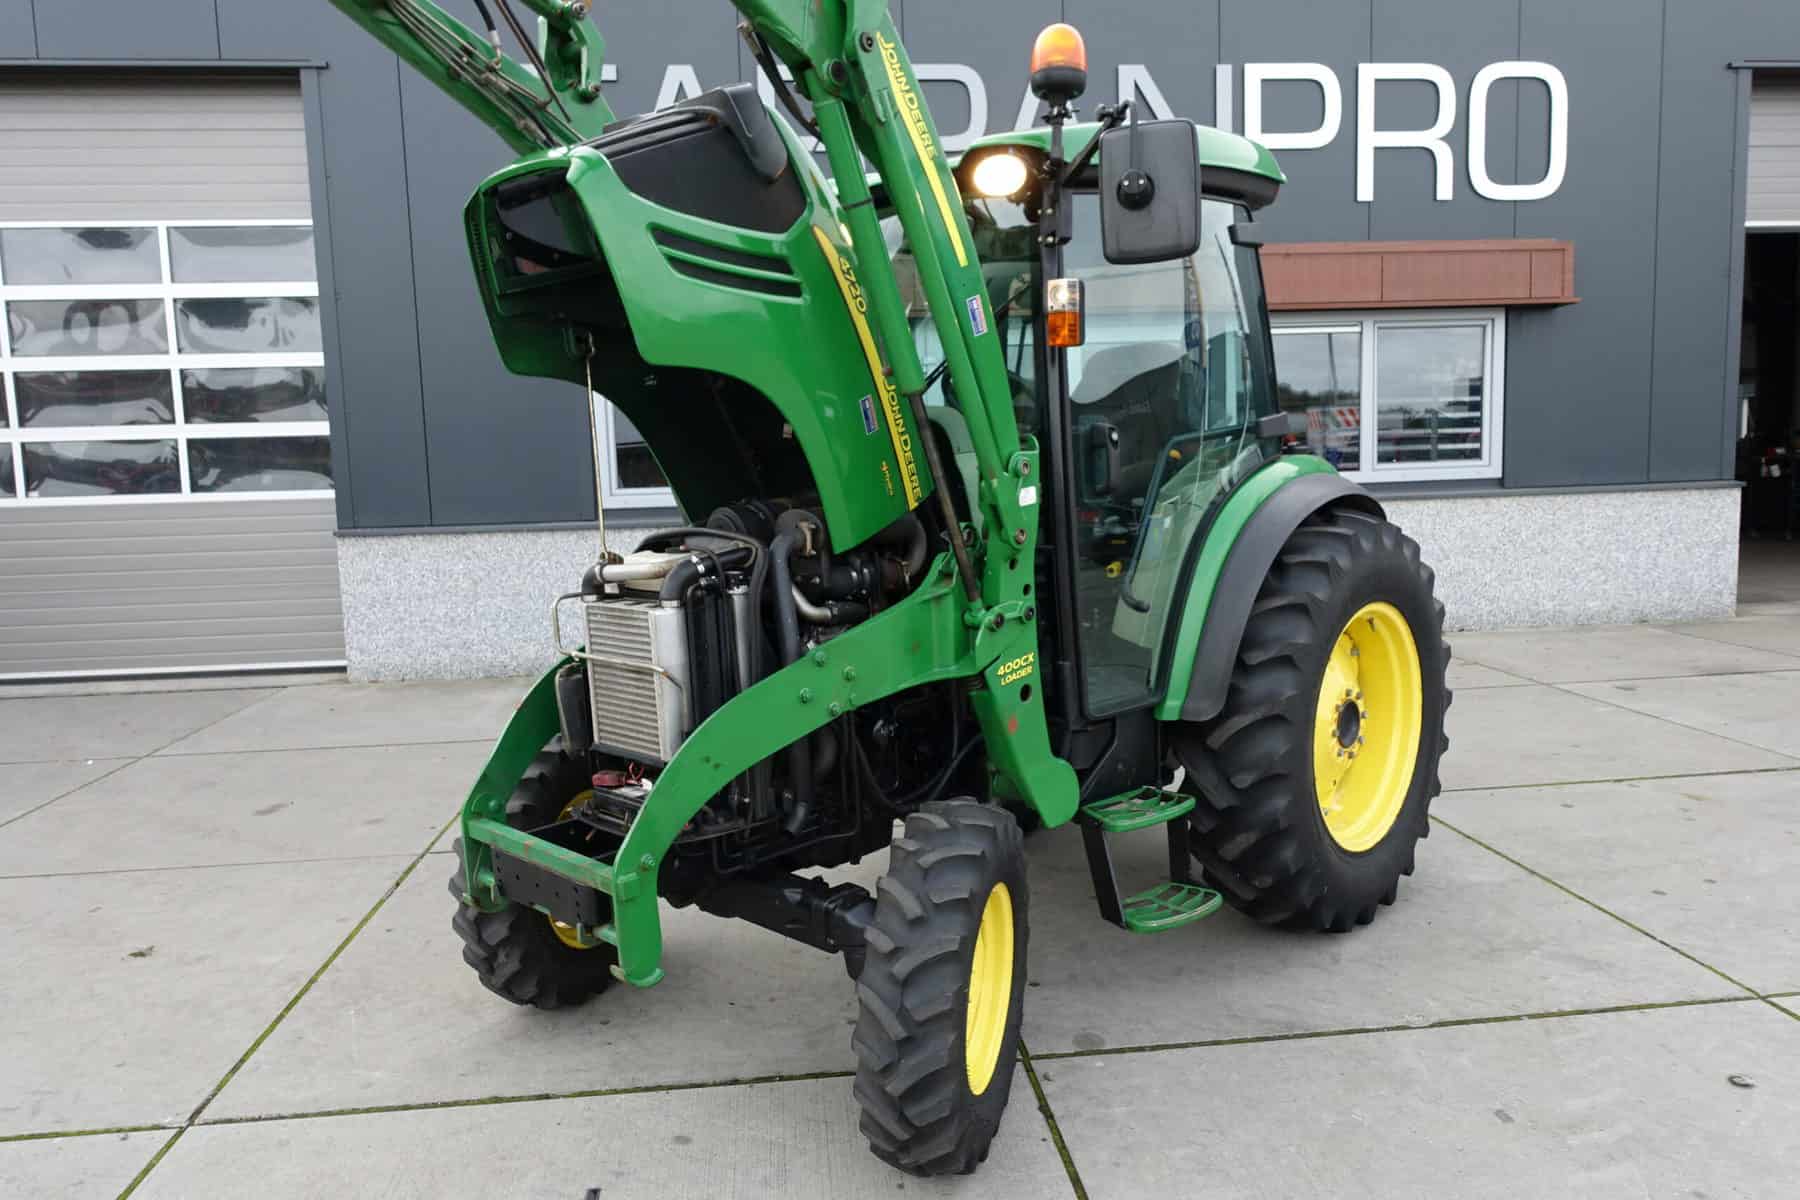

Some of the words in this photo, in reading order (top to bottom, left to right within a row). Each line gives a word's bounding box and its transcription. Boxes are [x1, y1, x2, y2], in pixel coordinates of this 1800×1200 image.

[880, 38, 910, 93] JOHN
[903, 91, 938, 161] DEERE
[883, 377, 906, 434] JOHN
[901, 434, 922, 500] DEERE
[997, 651, 1034, 675] 400CX
[1001, 665, 1032, 685] LOADER
